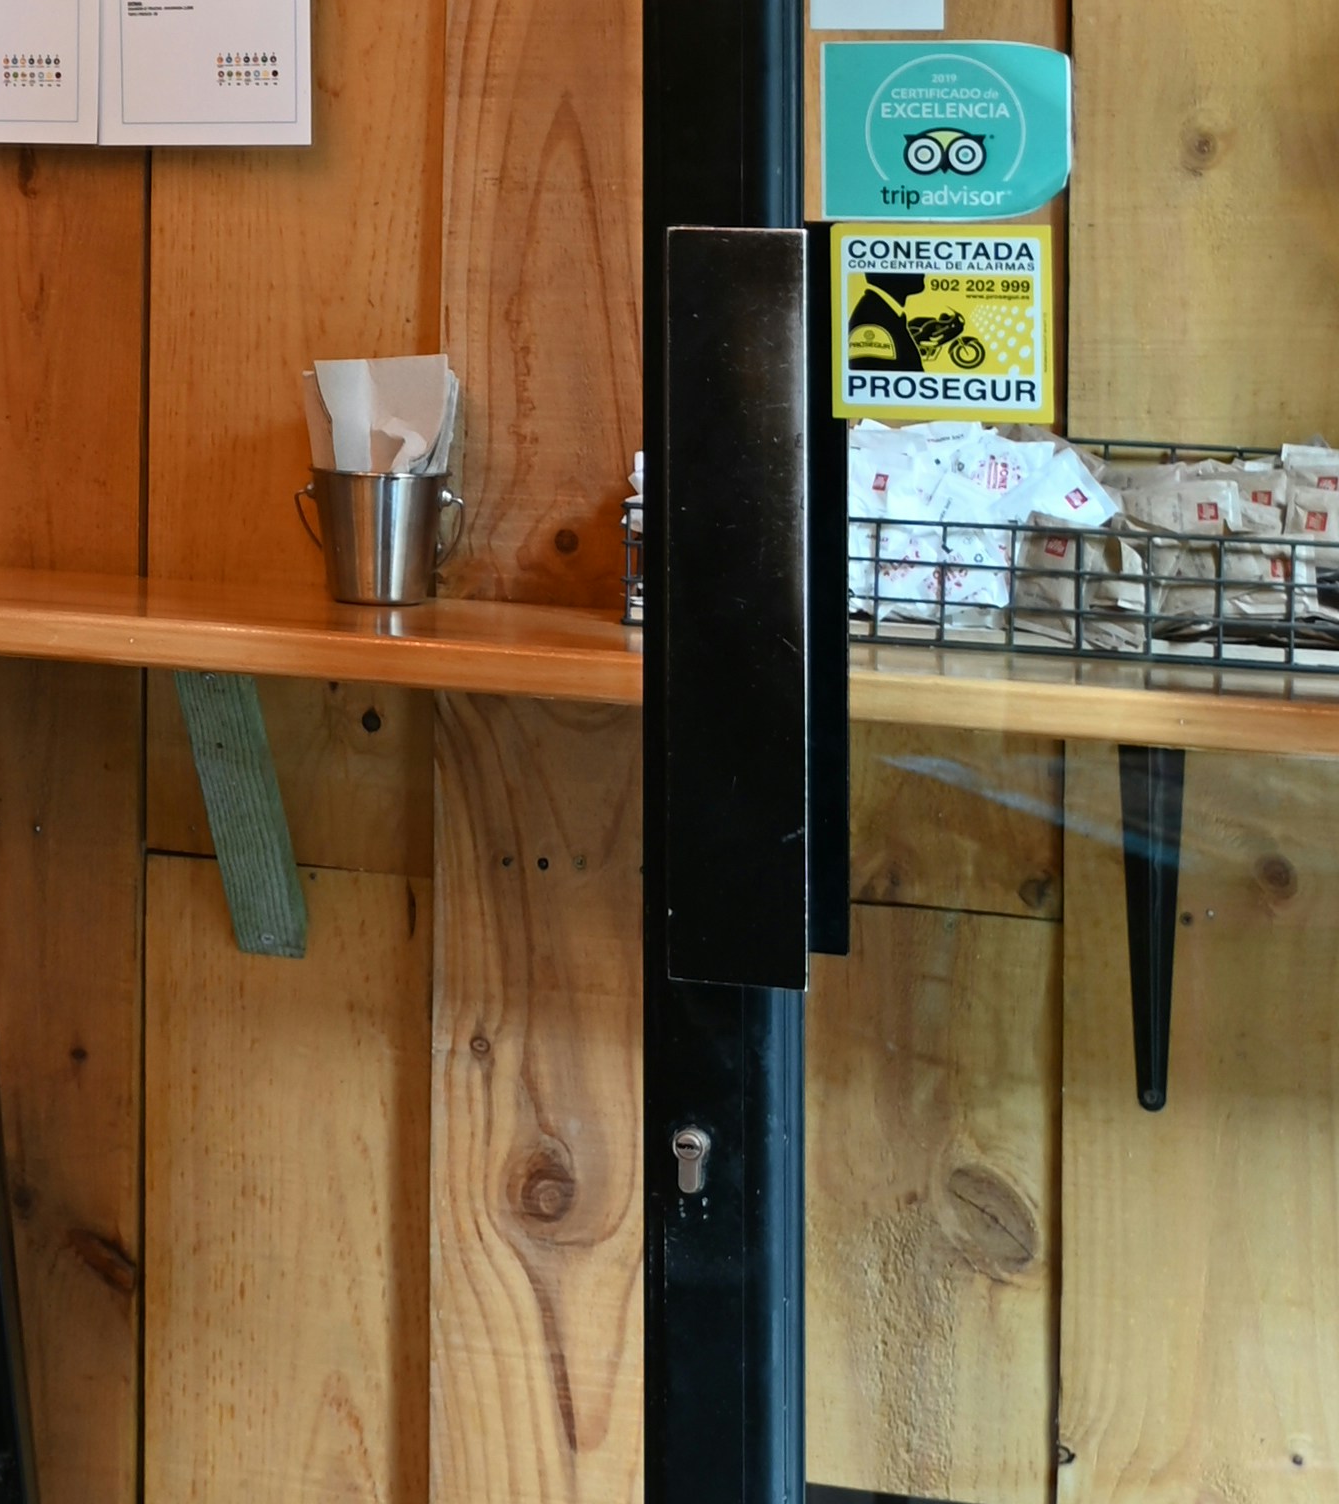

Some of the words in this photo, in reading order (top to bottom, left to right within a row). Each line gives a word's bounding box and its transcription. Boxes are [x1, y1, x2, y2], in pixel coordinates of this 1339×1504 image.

[931, 73, 957, 84] 2019
[890, 87, 981, 99] CERTIFICADO
[983, 88, 999, 99] de
[880, 102, 1011, 119] EXCELENCIA
[879, 184, 1006, 210] tripadvisor
[848, 239, 1035, 261] CONECTADA
[848, 259, 878, 269] CON
[880, 259, 941, 270] CENTRAL
[945, 260, 963, 271] DE
[966, 260, 1035, 272] ALARMAS
[929, 278, 960, 292] 902
[965, 279, 995, 292] 202
[1000, 279, 1031, 293] 999
[847, 375, 1037, 402] PROSEGUR
